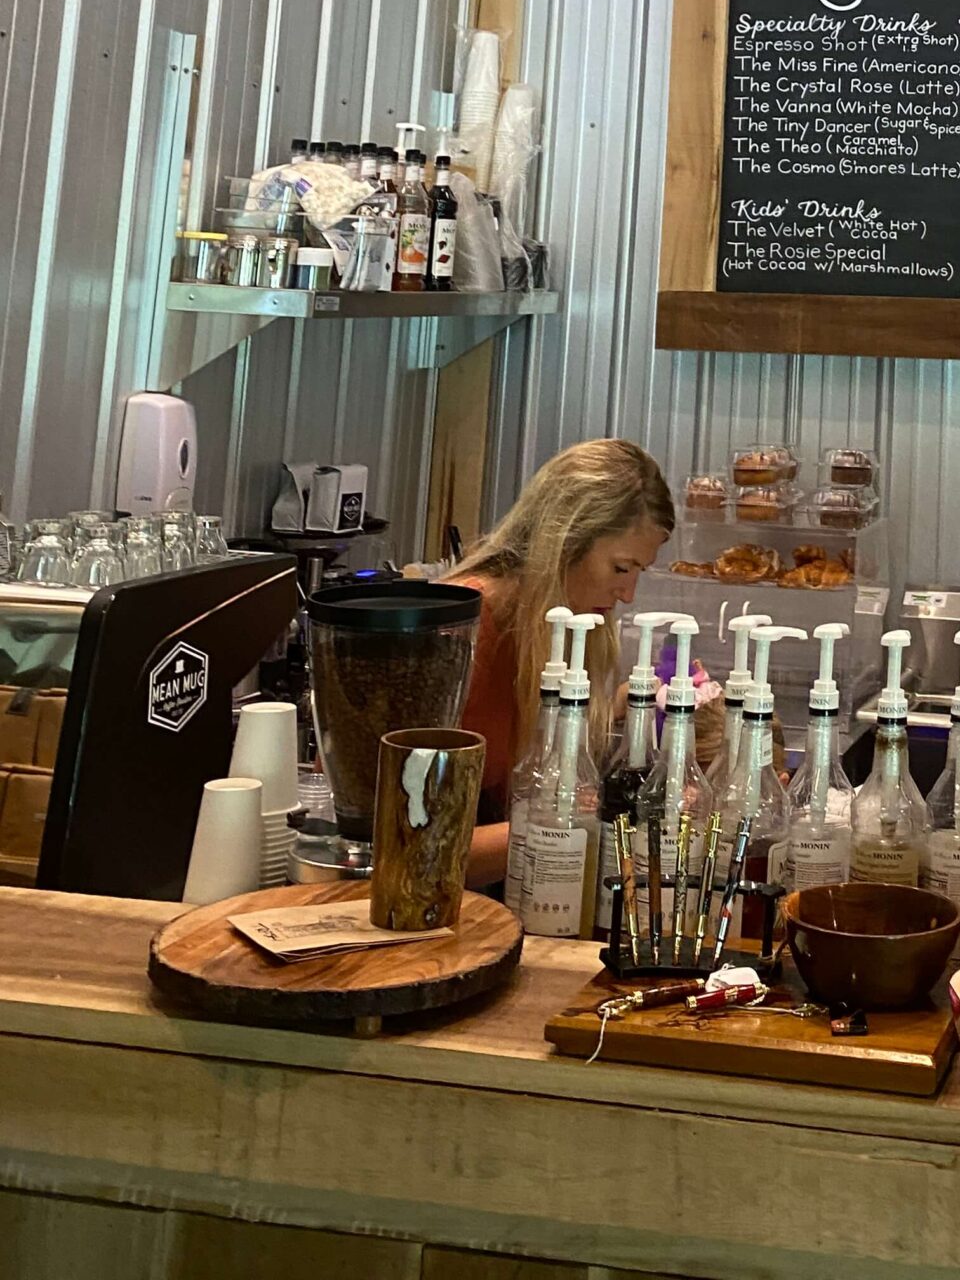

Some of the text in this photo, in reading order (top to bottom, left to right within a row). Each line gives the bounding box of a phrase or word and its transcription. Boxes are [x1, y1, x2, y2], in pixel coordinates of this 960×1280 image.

[735, 12, 937, 39] Specialty Drinks
[733, 35, 815, 58] Espresso
[821, 36, 868, 52] Shot
[872, 33, 919, 52] (Extra
[922, 33, 959, 52] Shot)
[902, 44, 918, 53] 1.5
[734, 55, 772, 71] The
[778, 56, 818, 72] Miss
[822, 57, 858, 73] Fine
[733, 76, 771, 93] The
[776, 76, 842, 99] Crystal
[850, 78, 893, 94] Rose
[899, 79, 960, 97] (Latte)
[734, 96, 770, 113] The
[775, 98, 832, 113] Vanna
[836, 97, 892, 115] (White
[896, 100, 959, 118] Mocha)
[731, 116, 768, 132] The
[772, 116, 810, 141] Tiny
[814, 118, 872, 134] Dancer
[731, 137, 771, 153] The
[775, 137, 822, 153] Theo
[731, 157, 771, 173] The
[777, 158, 836, 174] Cosmo
[838, 157, 906, 176] (S'mores
[731, 198, 882, 222] Kids' Drinks
[727, 219, 767, 236] The
[769, 221, 826, 238] Velvet
[850, 228, 898, 240] Cocoa
[727, 240, 766, 258] The
[769, 242, 822, 259] Rosie
[824, 242, 887, 265] Special
[722, 257, 955, 282] (Hot Cocoa w/ Marshmallows)
[152, 670, 205, 704] MEAN MUG
[541, 830, 570, 839] MONIN
[800, 842, 831, 850] MONIN
[872, 852, 904, 861] MONIN
